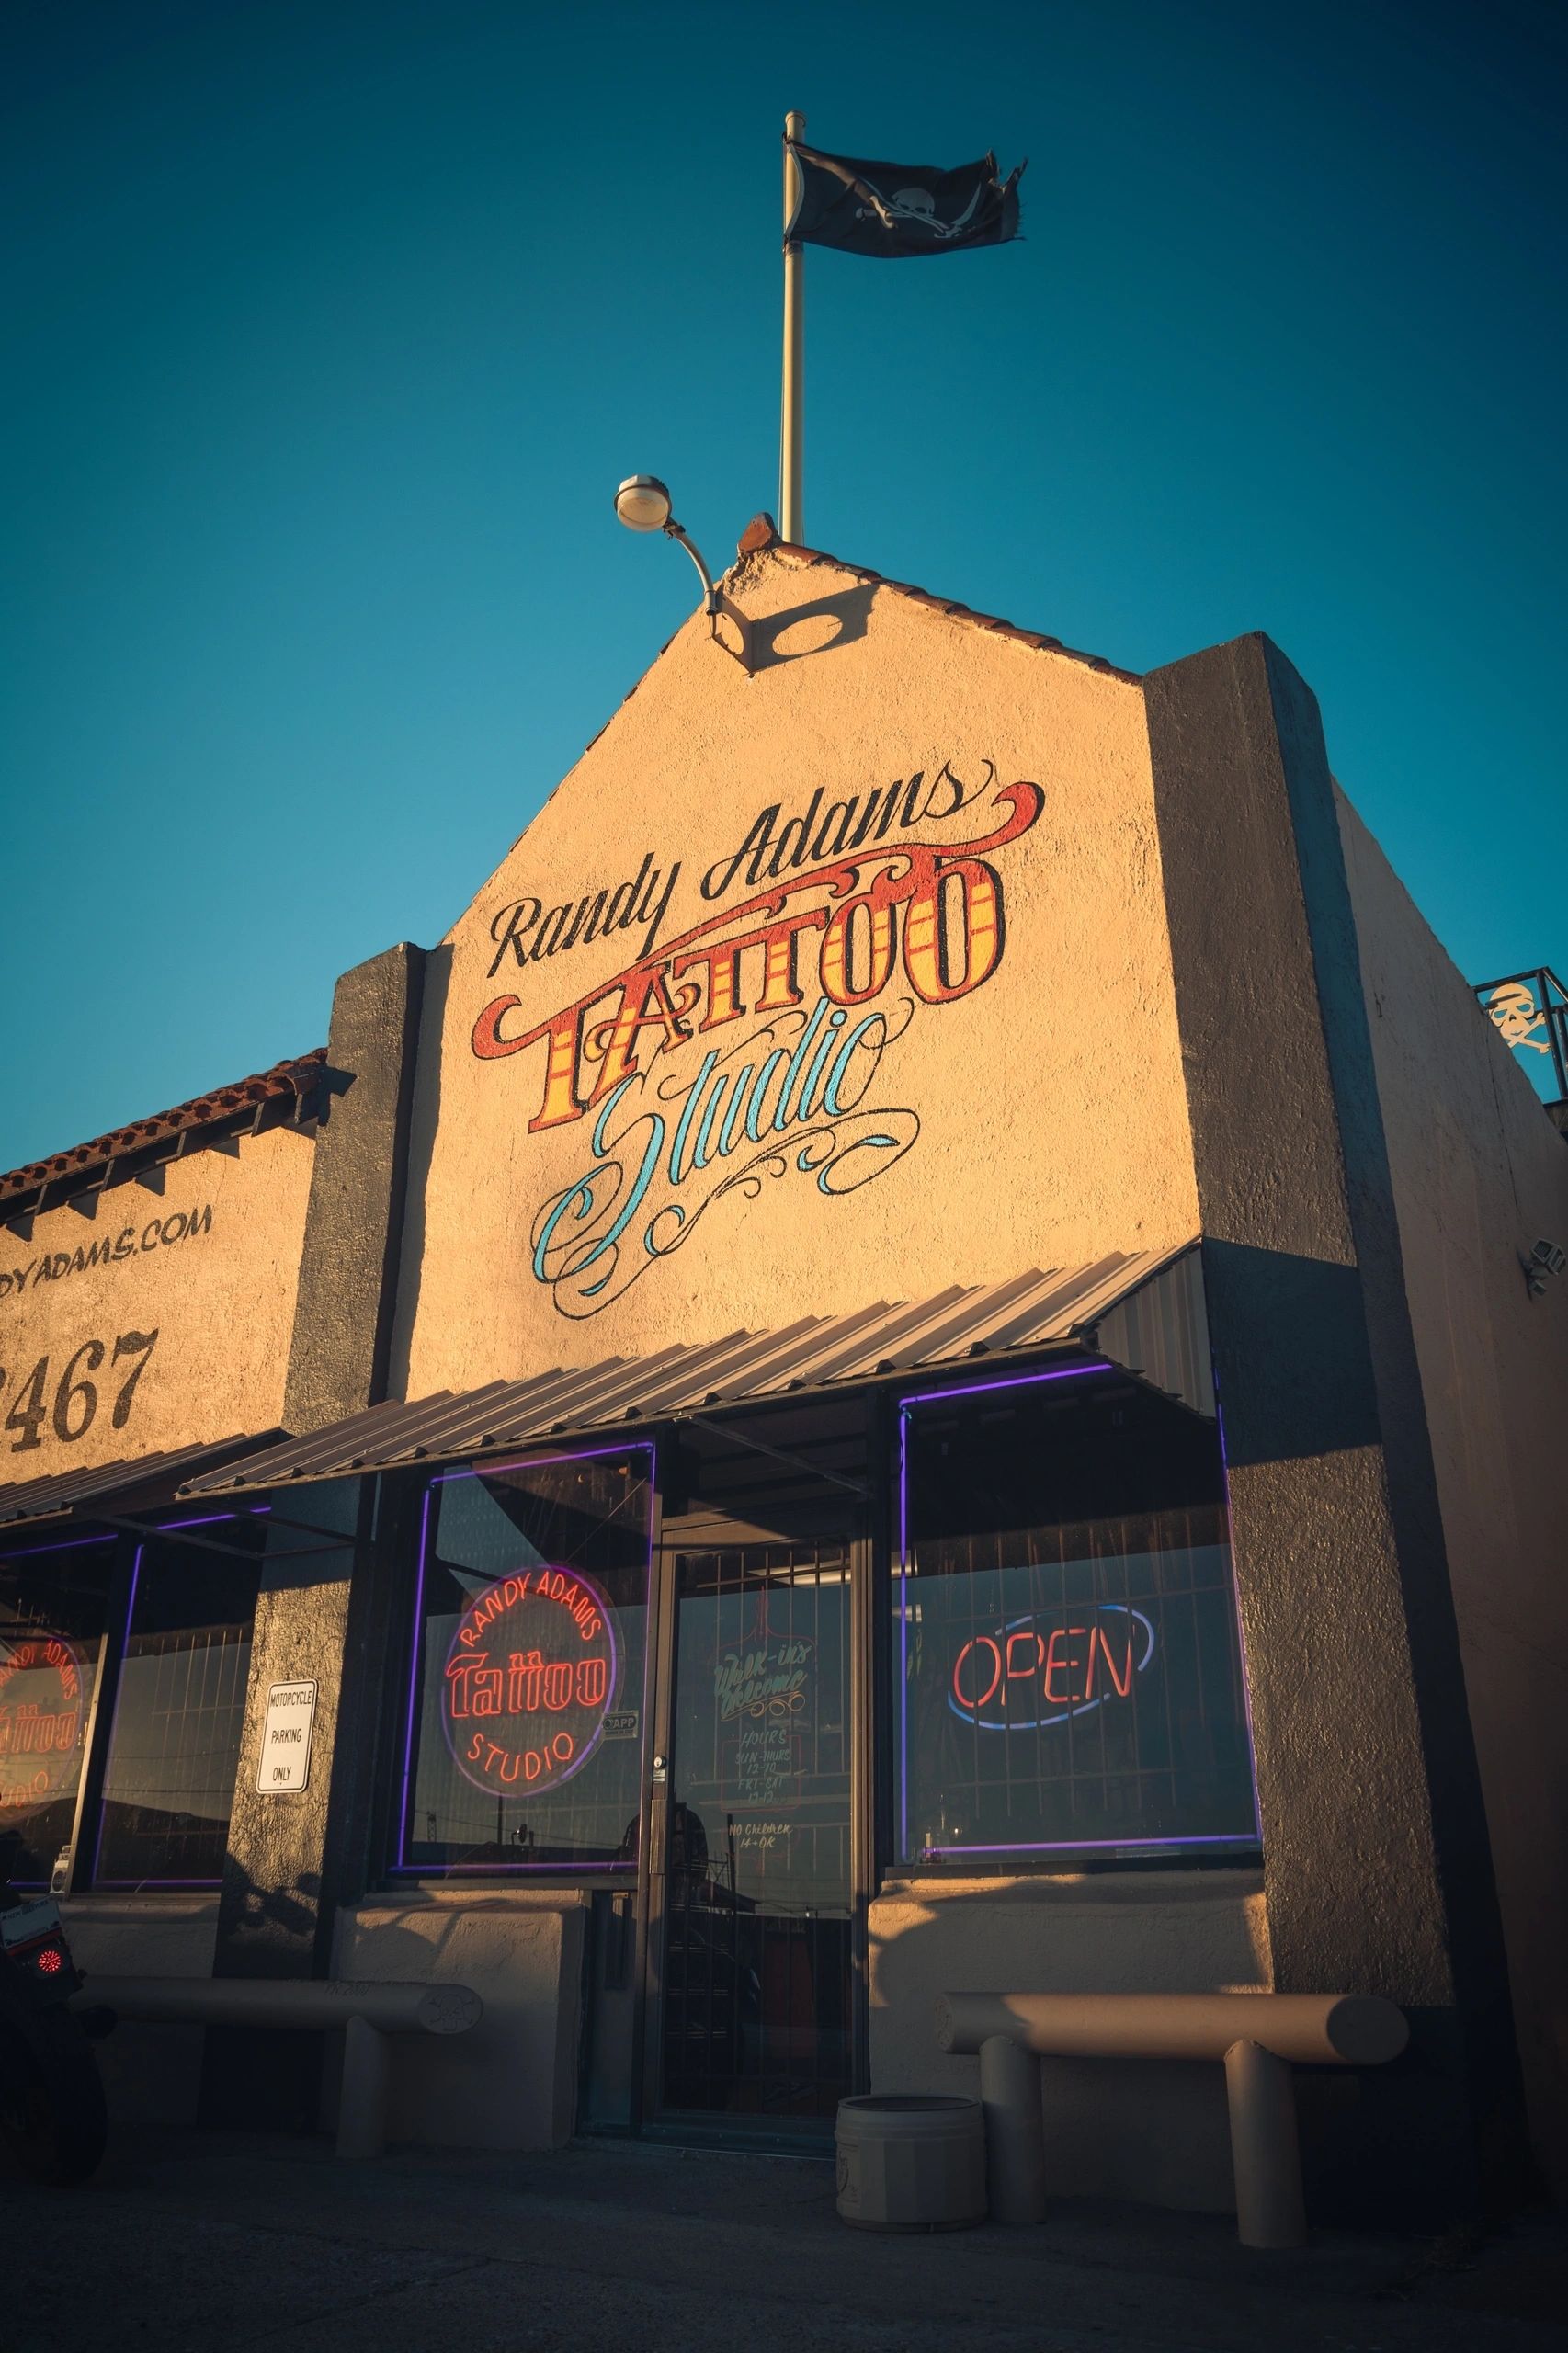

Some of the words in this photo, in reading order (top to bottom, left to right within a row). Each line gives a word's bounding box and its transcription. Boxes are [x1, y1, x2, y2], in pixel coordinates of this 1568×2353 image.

[487, 851, 681, 978] Randy
[700, 759, 994, 900] Adams
[471, 781, 1045, 1133] TATTOO
[531, 996, 919, 1320] Studio
[0, 1328, 159, 1453] 467
[460, 1573, 532, 1647] RANDY
[537, 1571, 602, 1641] ADAMS
[446, 1650, 607, 1718] Tattoo
[721, 1669, 808, 1718] Welcome
[953, 1624, 1136, 1710] OPEN
[269, 1690, 312, 1708] MOTORCYCLE
[271, 1728, 302, 1745] PARKING
[467, 1732, 574, 1781] STUDIO
[740, 1729, 788, 1748] HOURS
[272, 1767, 292, 1782] ONLY
[729, 1824, 743, 1836] NO
